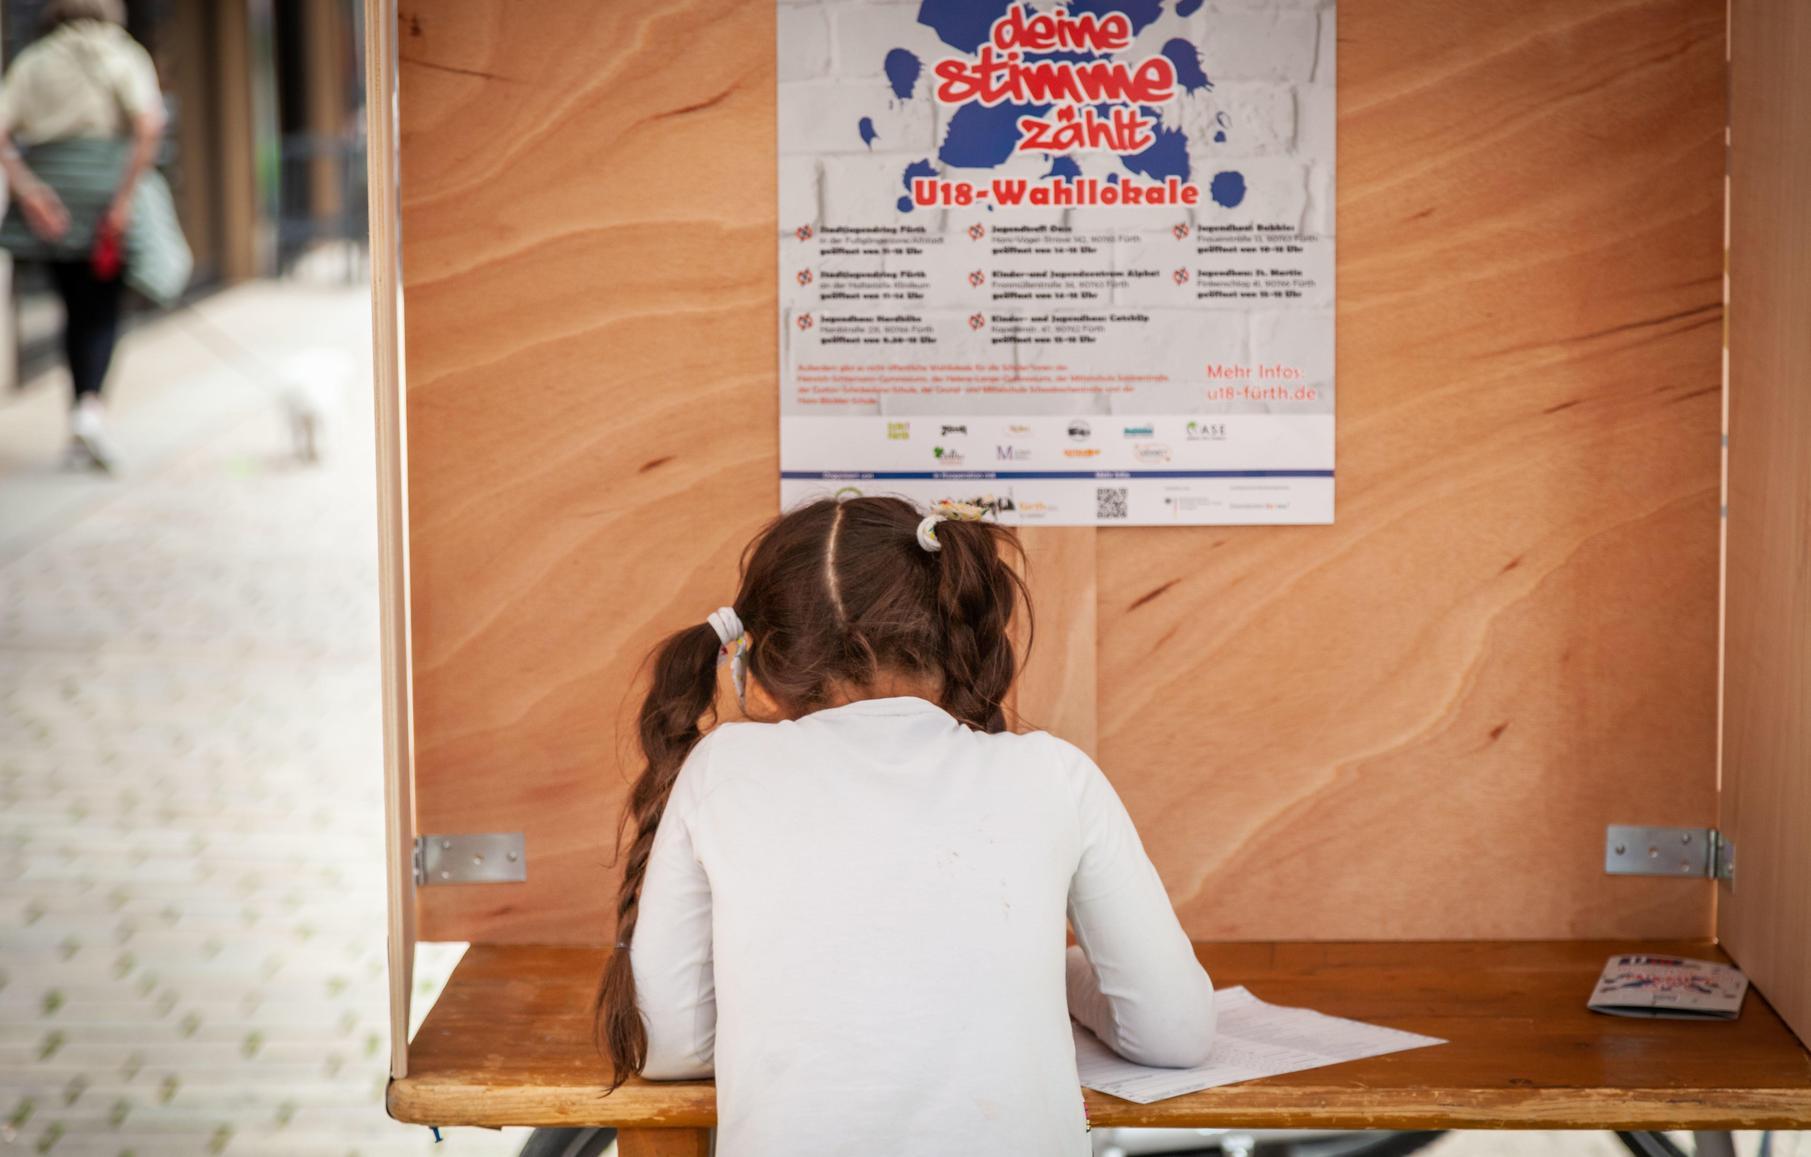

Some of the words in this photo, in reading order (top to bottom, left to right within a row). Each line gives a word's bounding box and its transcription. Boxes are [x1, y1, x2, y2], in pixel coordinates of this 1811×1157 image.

[992, 7, 1131, 53] deine
[932, 45, 1176, 103] stimme
[1017, 106, 1155, 153] zählt
[913, 179, 1199, 207] U18-Wahllokale
[1207, 365, 1251, 379] Mehr
[1259, 365, 1304, 379] Infos:
[1207, 385, 1316, 400] u18-fürth.de
